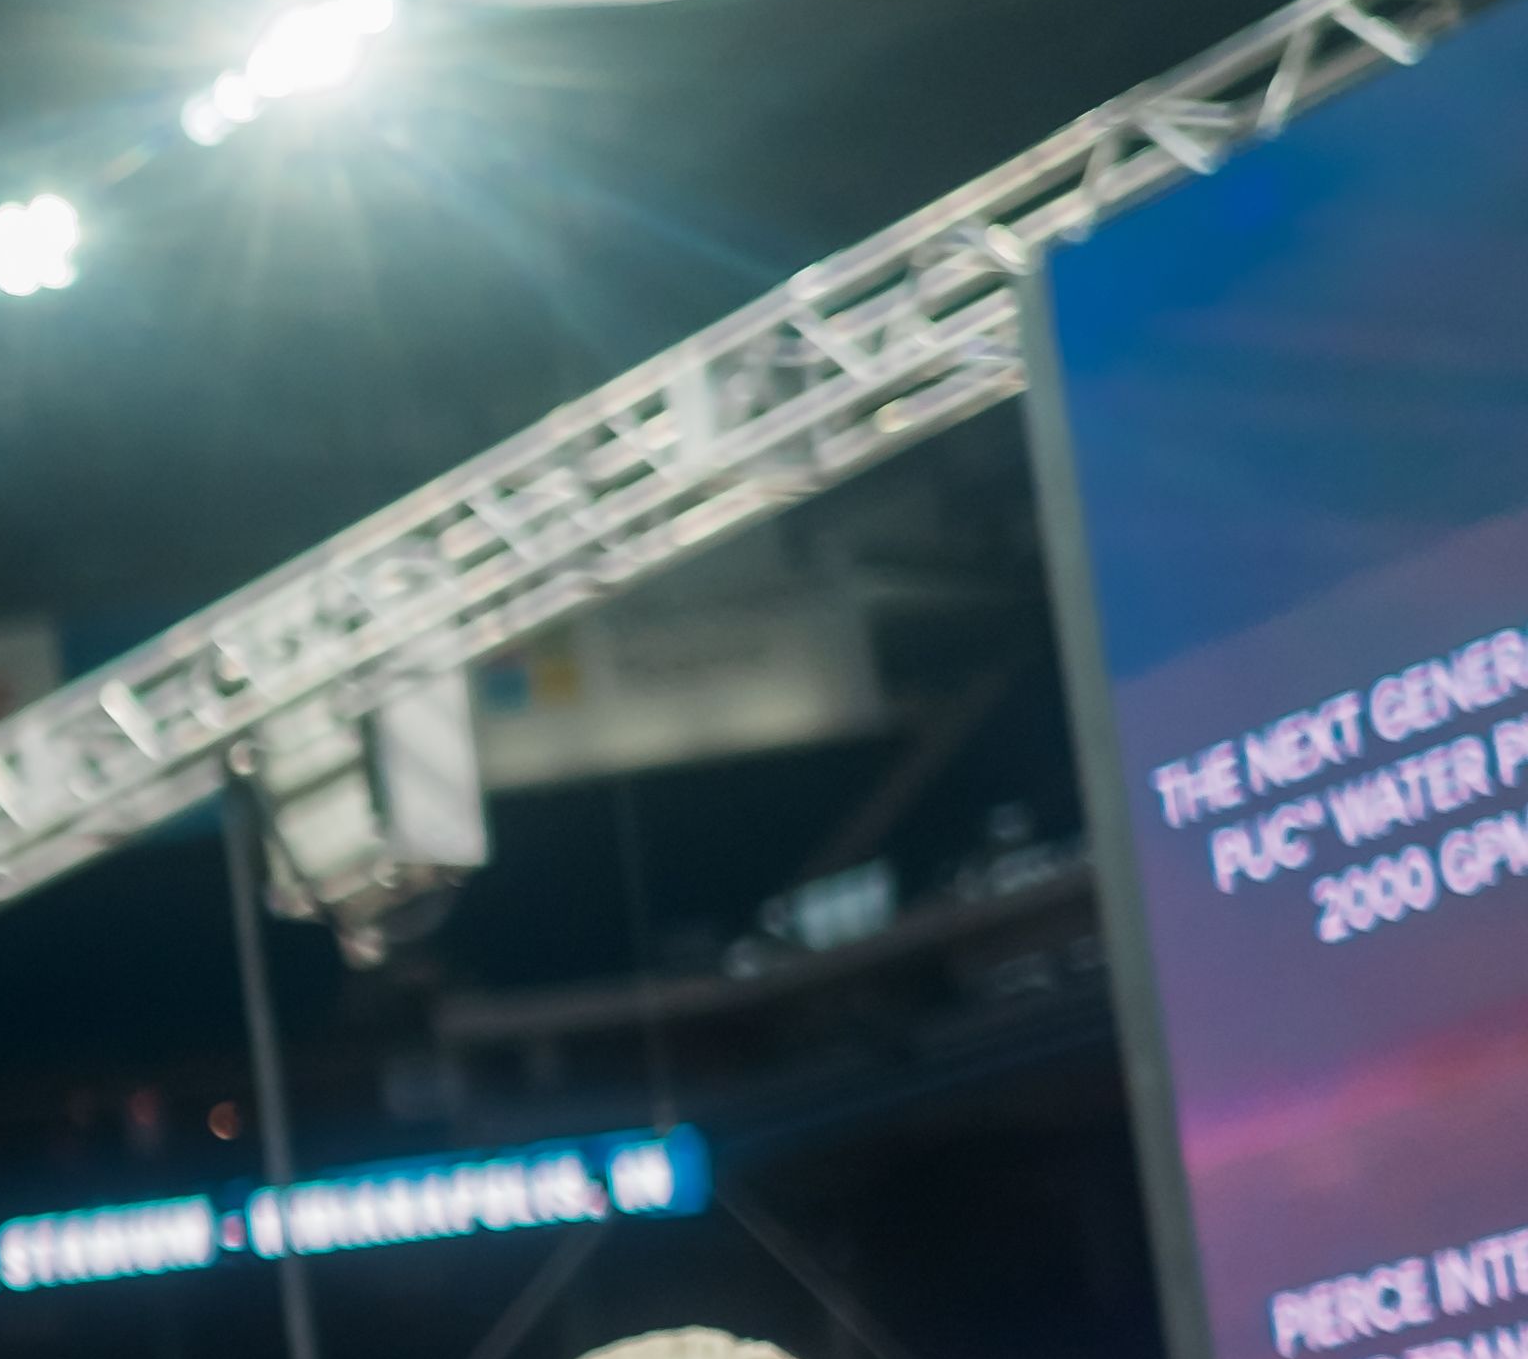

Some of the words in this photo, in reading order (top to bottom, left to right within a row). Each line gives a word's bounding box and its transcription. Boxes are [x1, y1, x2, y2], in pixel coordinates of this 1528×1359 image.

[1152, 740, 1244, 828] THE
[1244, 690, 1363, 795] NEXT
[1326, 734, 1494, 846] WATER
[1312, 844, 1438, 943] 2000
[1271, 1255, 1434, 1359] PIERCE
